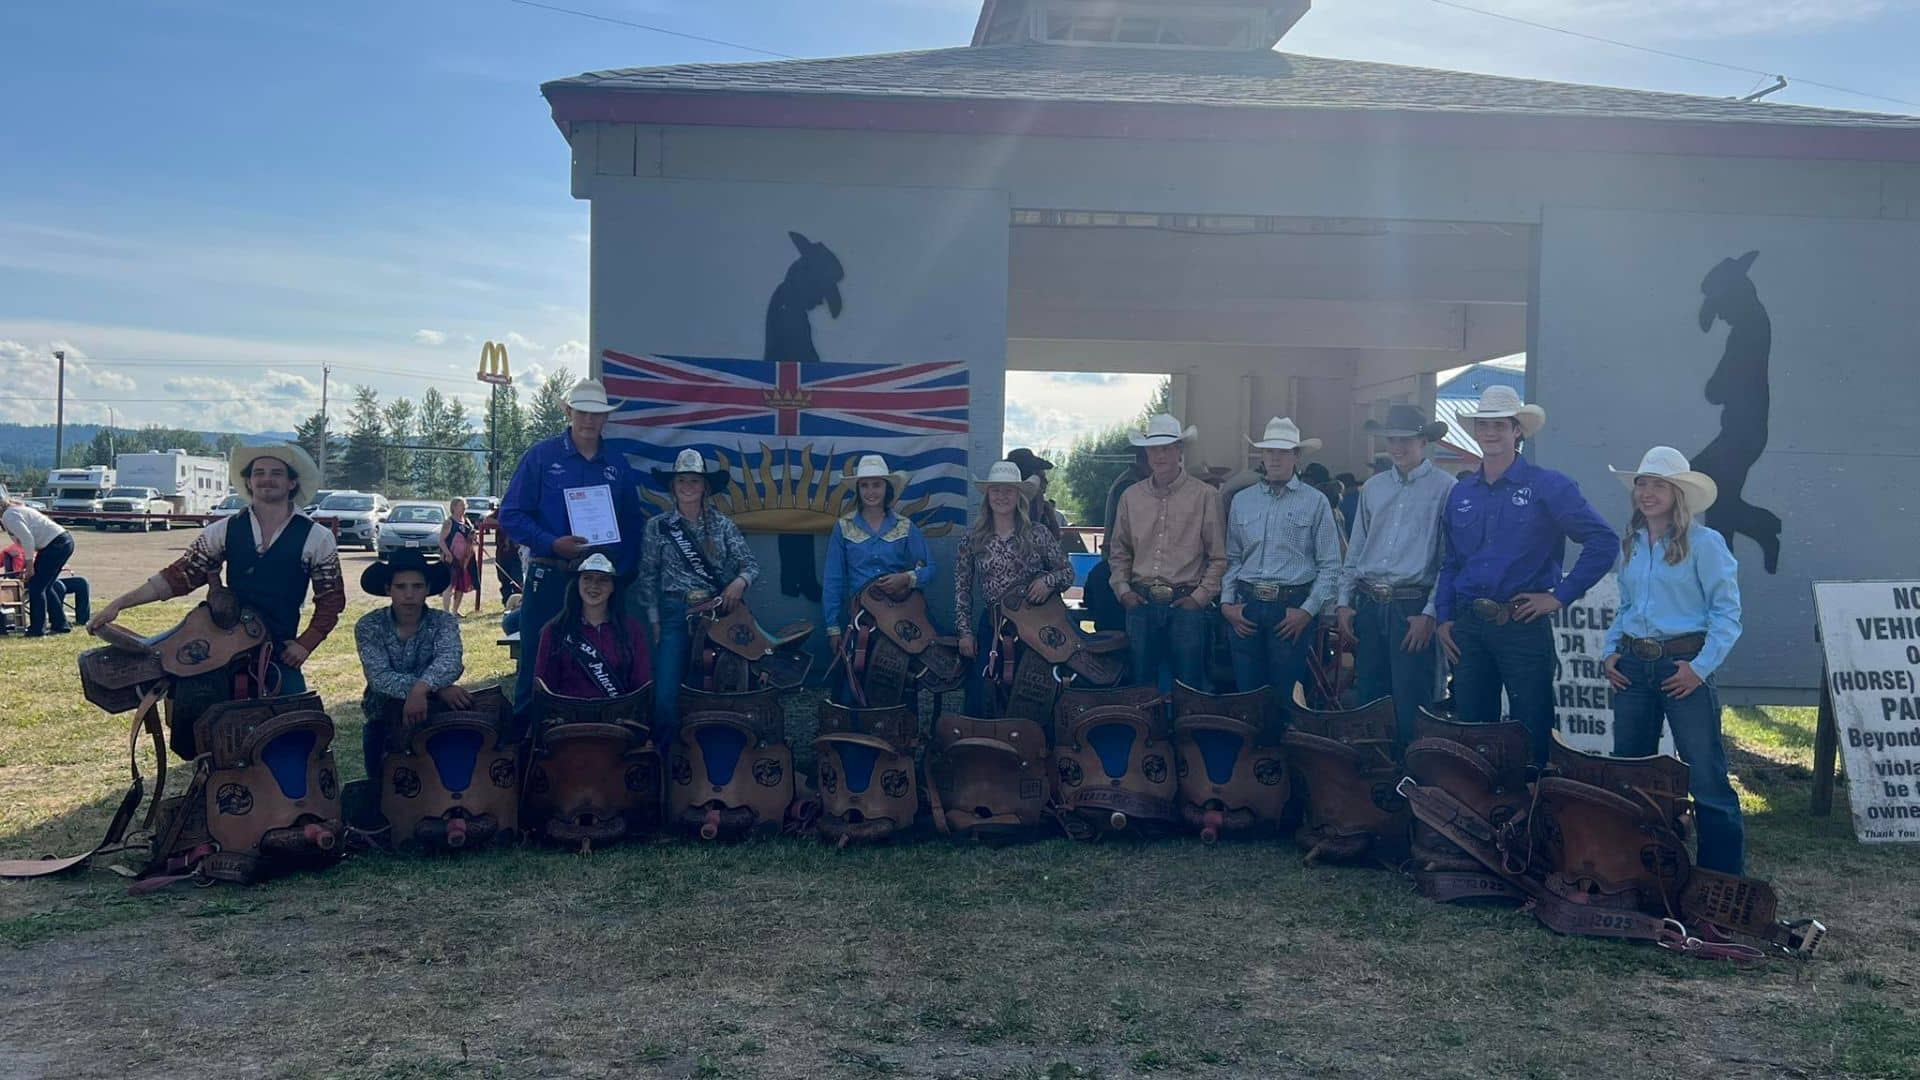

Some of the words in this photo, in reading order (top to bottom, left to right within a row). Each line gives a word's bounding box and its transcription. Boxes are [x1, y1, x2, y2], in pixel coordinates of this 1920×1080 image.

[1833, 670, 1915, 695] (HORSE)
[1567, 714, 1606, 735] this
[1884, 781, 1909, 797] be
[1865, 830, 1895, 838] Thank
[1898, 830, 1916, 838] You
